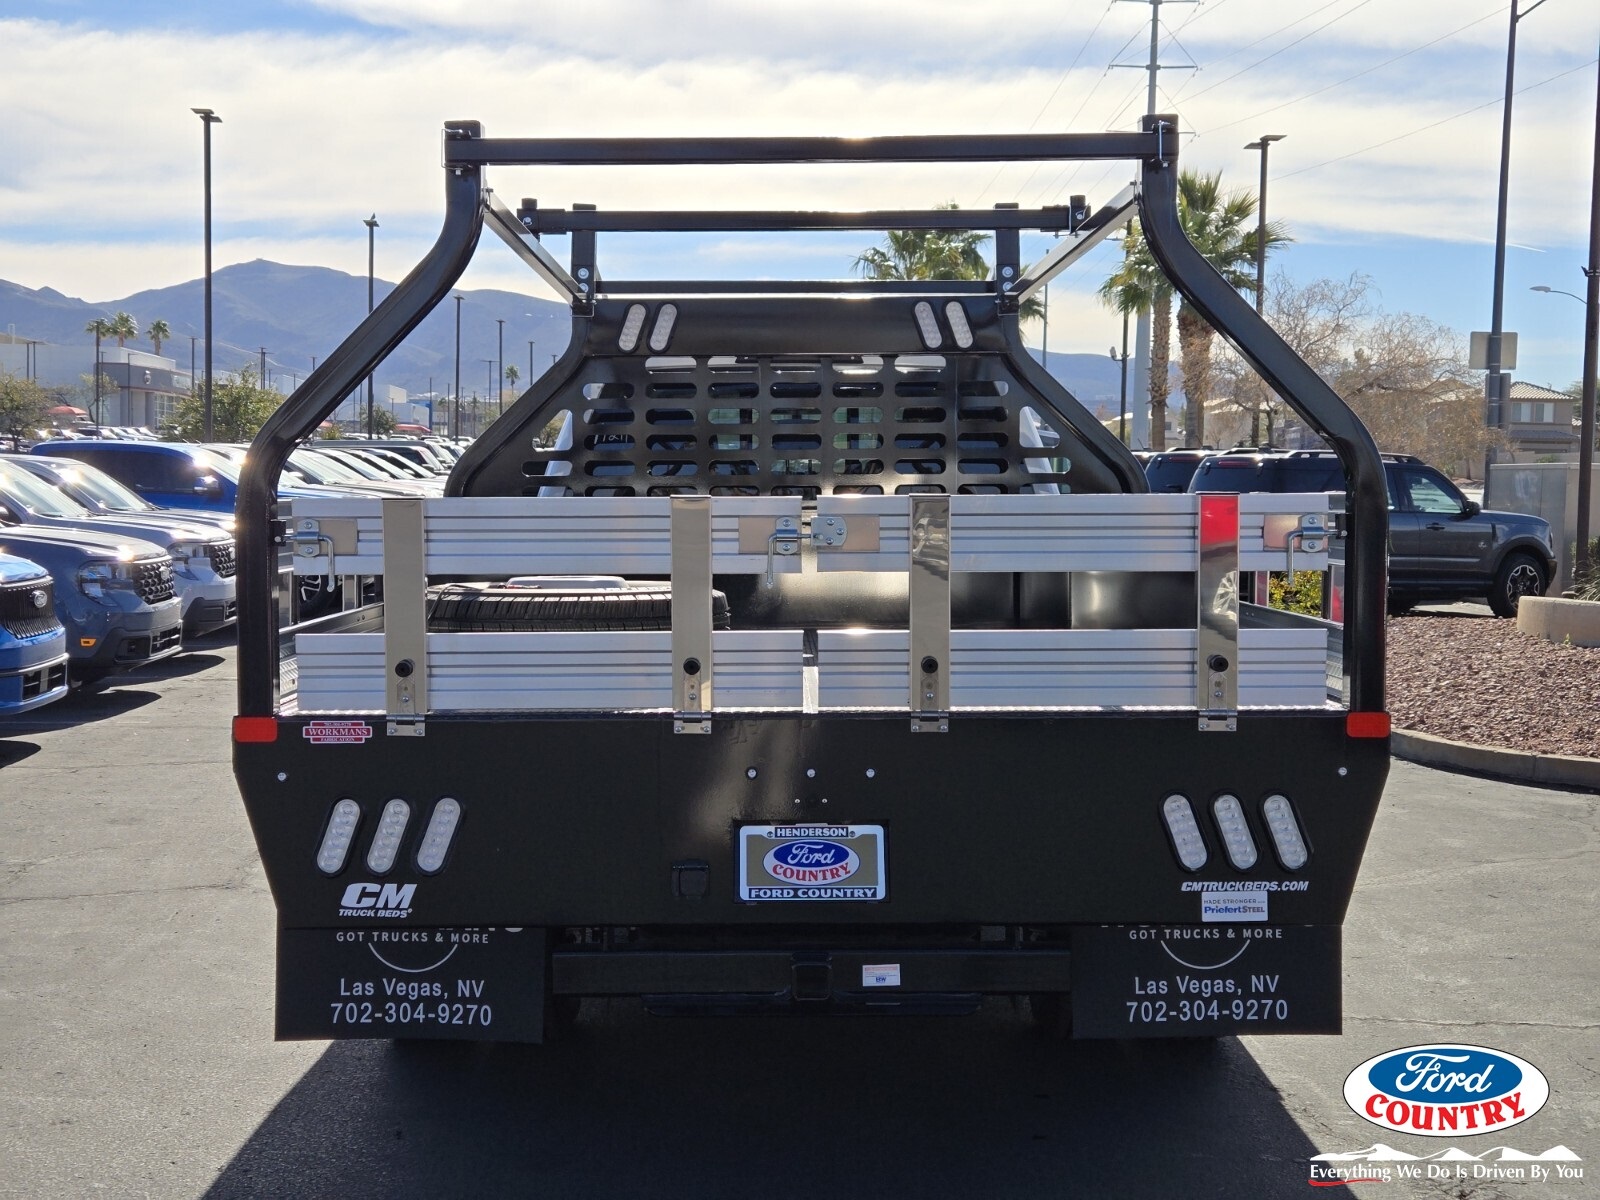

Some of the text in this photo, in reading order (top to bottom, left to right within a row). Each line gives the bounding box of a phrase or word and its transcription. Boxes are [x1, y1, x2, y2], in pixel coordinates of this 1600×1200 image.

[308, 728, 368, 736] WORKMANS
[776, 827, 847, 837] HENDERSON
[787, 843, 835, 865] Ford
[772, 863, 851, 881] COUNTRY
[751, 888, 876, 898] FORD COUNTRY
[1181, 881, 1309, 892] CMTRUCKBEDS.COM
[340, 883, 417, 909] CM
[338, 909, 376, 917] TRUCK
[336, 932, 489, 944] GOT TRUCKS & MORE
[1129, 928, 1283, 940] GOT TRUCKS & MORE
[340, 978, 485, 999] Las Vegas, NV
[1134, 974, 1280, 996] Las Vegas, NV
[330, 1002, 492, 1026] 702-304-9270
[1126, 1000, 1288, 1022] 702-304-9270
